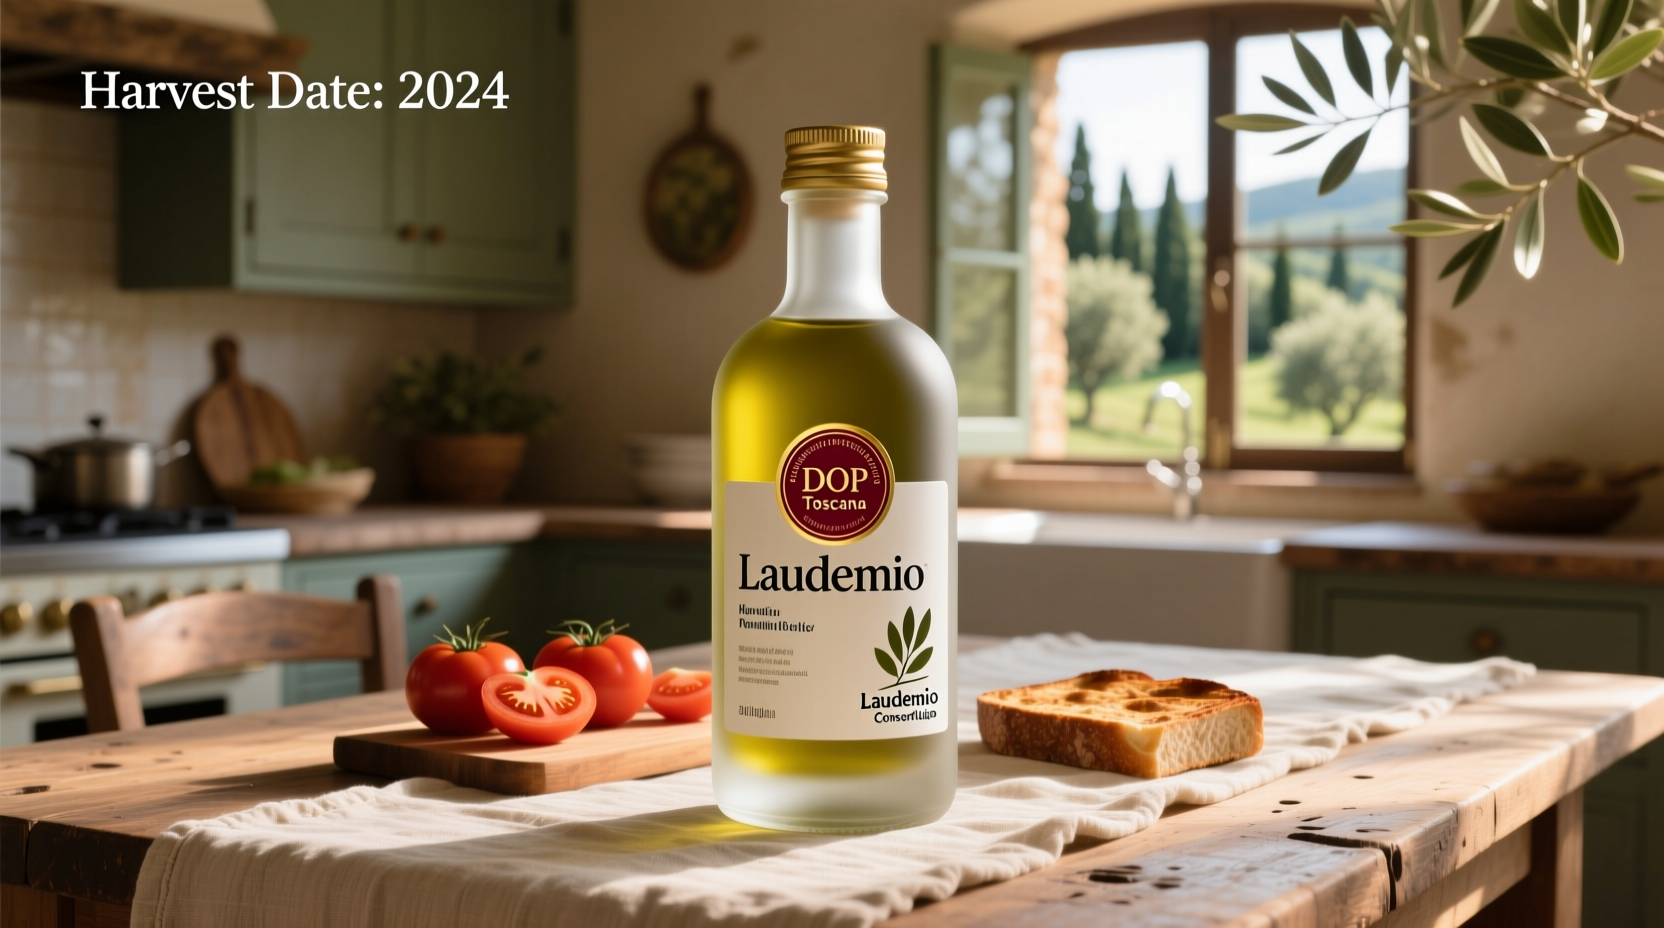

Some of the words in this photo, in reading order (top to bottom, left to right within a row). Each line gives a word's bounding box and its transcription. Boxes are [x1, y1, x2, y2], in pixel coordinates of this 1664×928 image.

[802, 467, 869, 493] DOP
[802, 495, 867, 511] Toscana
[738, 553, 925, 593] Laudemio
[860, 687, 939, 710] Laudemio
